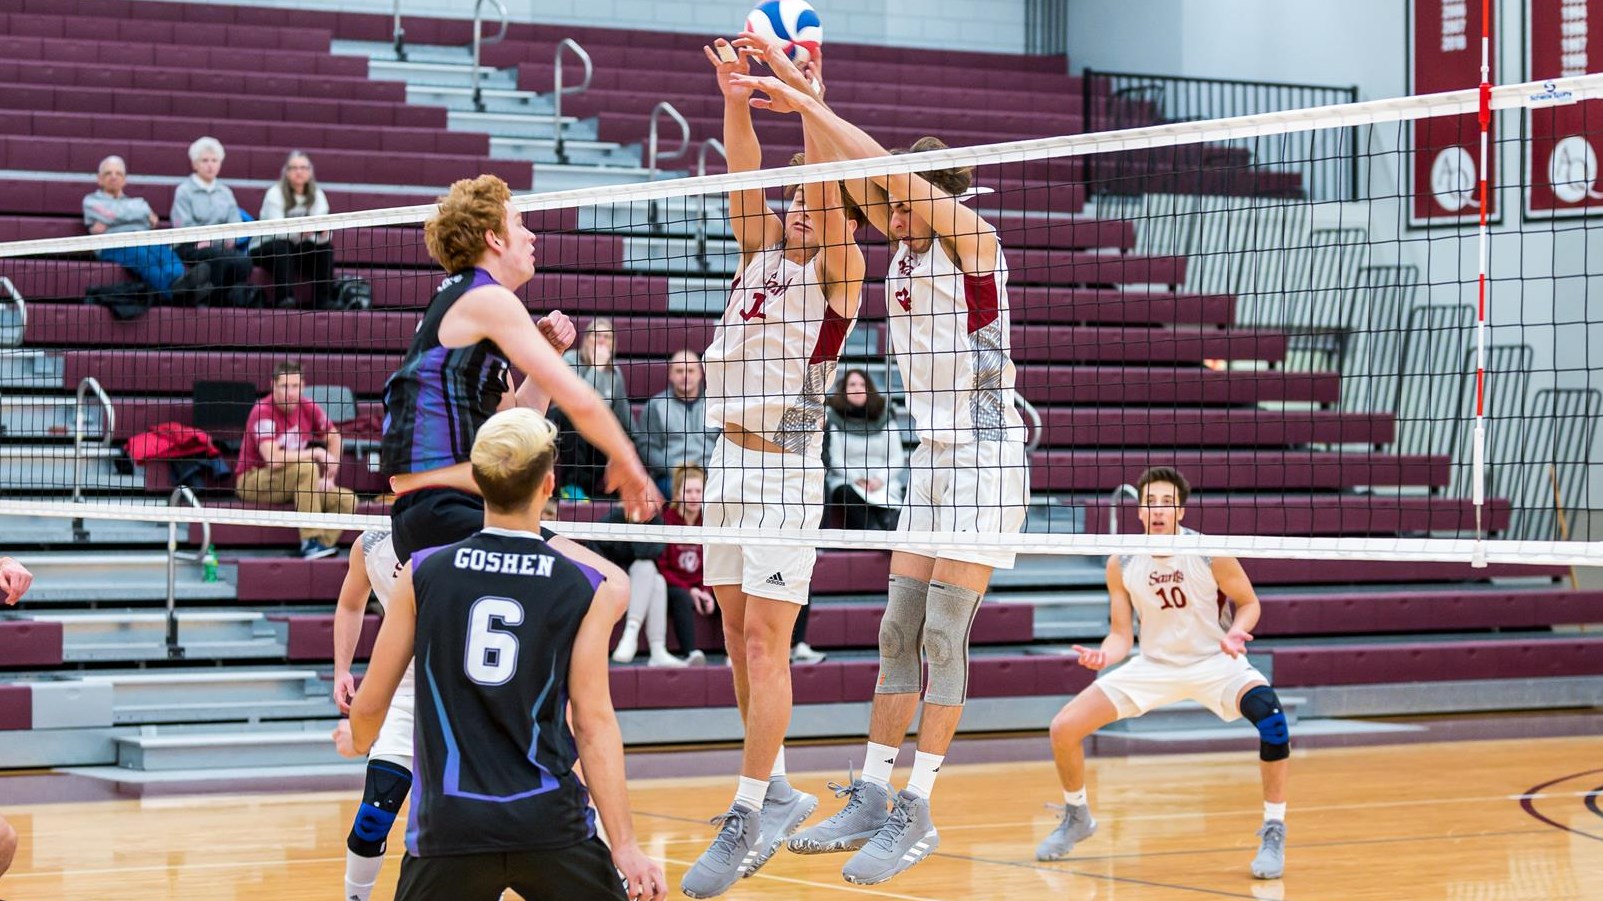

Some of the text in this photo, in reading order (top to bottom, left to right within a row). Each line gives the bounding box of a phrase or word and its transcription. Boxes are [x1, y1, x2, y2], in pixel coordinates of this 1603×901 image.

[454, 547, 556, 578] GOSHEN
[765, 578, 786, 587] adidas
[1149, 570, 1184, 586] Saints
[1155, 586, 1187, 610] 10
[463, 595, 525, 687] 6
